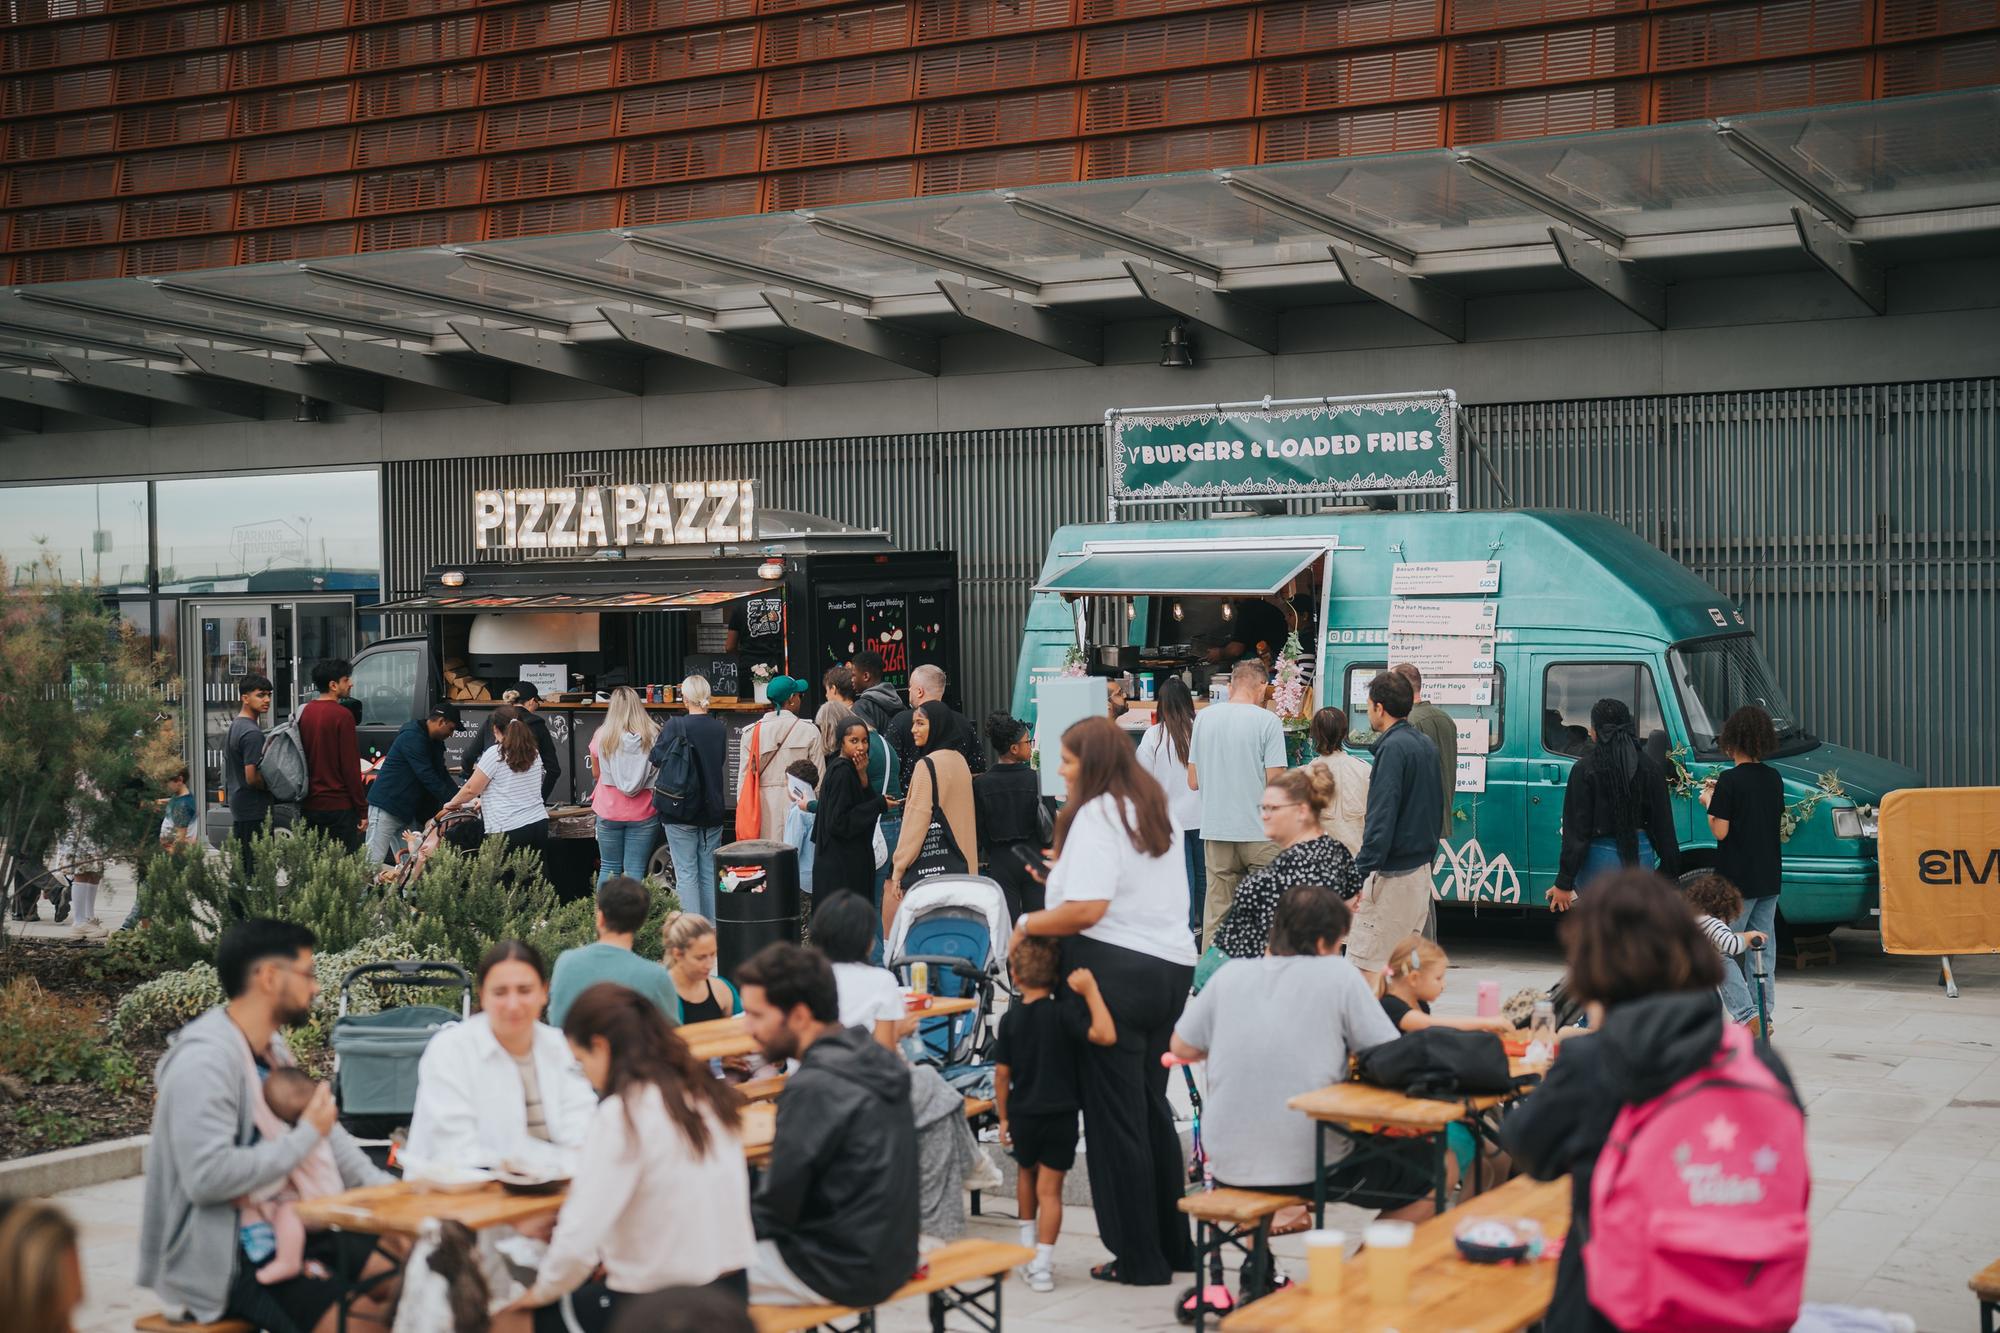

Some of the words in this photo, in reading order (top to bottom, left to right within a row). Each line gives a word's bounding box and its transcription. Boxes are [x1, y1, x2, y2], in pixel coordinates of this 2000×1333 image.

[1142, 440, 1245, 465] BURGERS
[1251, 442, 1263, 457] &
[1267, 434, 1361, 459] LOADED
[1367, 430, 1434, 454] FRIES
[475, 486, 610, 549] PIZZA
[615, 480, 756, 546] PAZZI
[237, 528, 282, 542] BARKING
[244, 540, 297, 553] RIVERSIDE
[828, 602, 842, 610] Private
[843, 601, 857, 609] Events
[866, 600, 885, 609] Corporate
[886, 599, 904, 608] Weddings
[1357, 630, 1389, 643] FEE
[1473, 661, 1493, 669] £10.5
[712, 677, 737, 693] £10
[918, 866, 946, 875] SEPHORA
